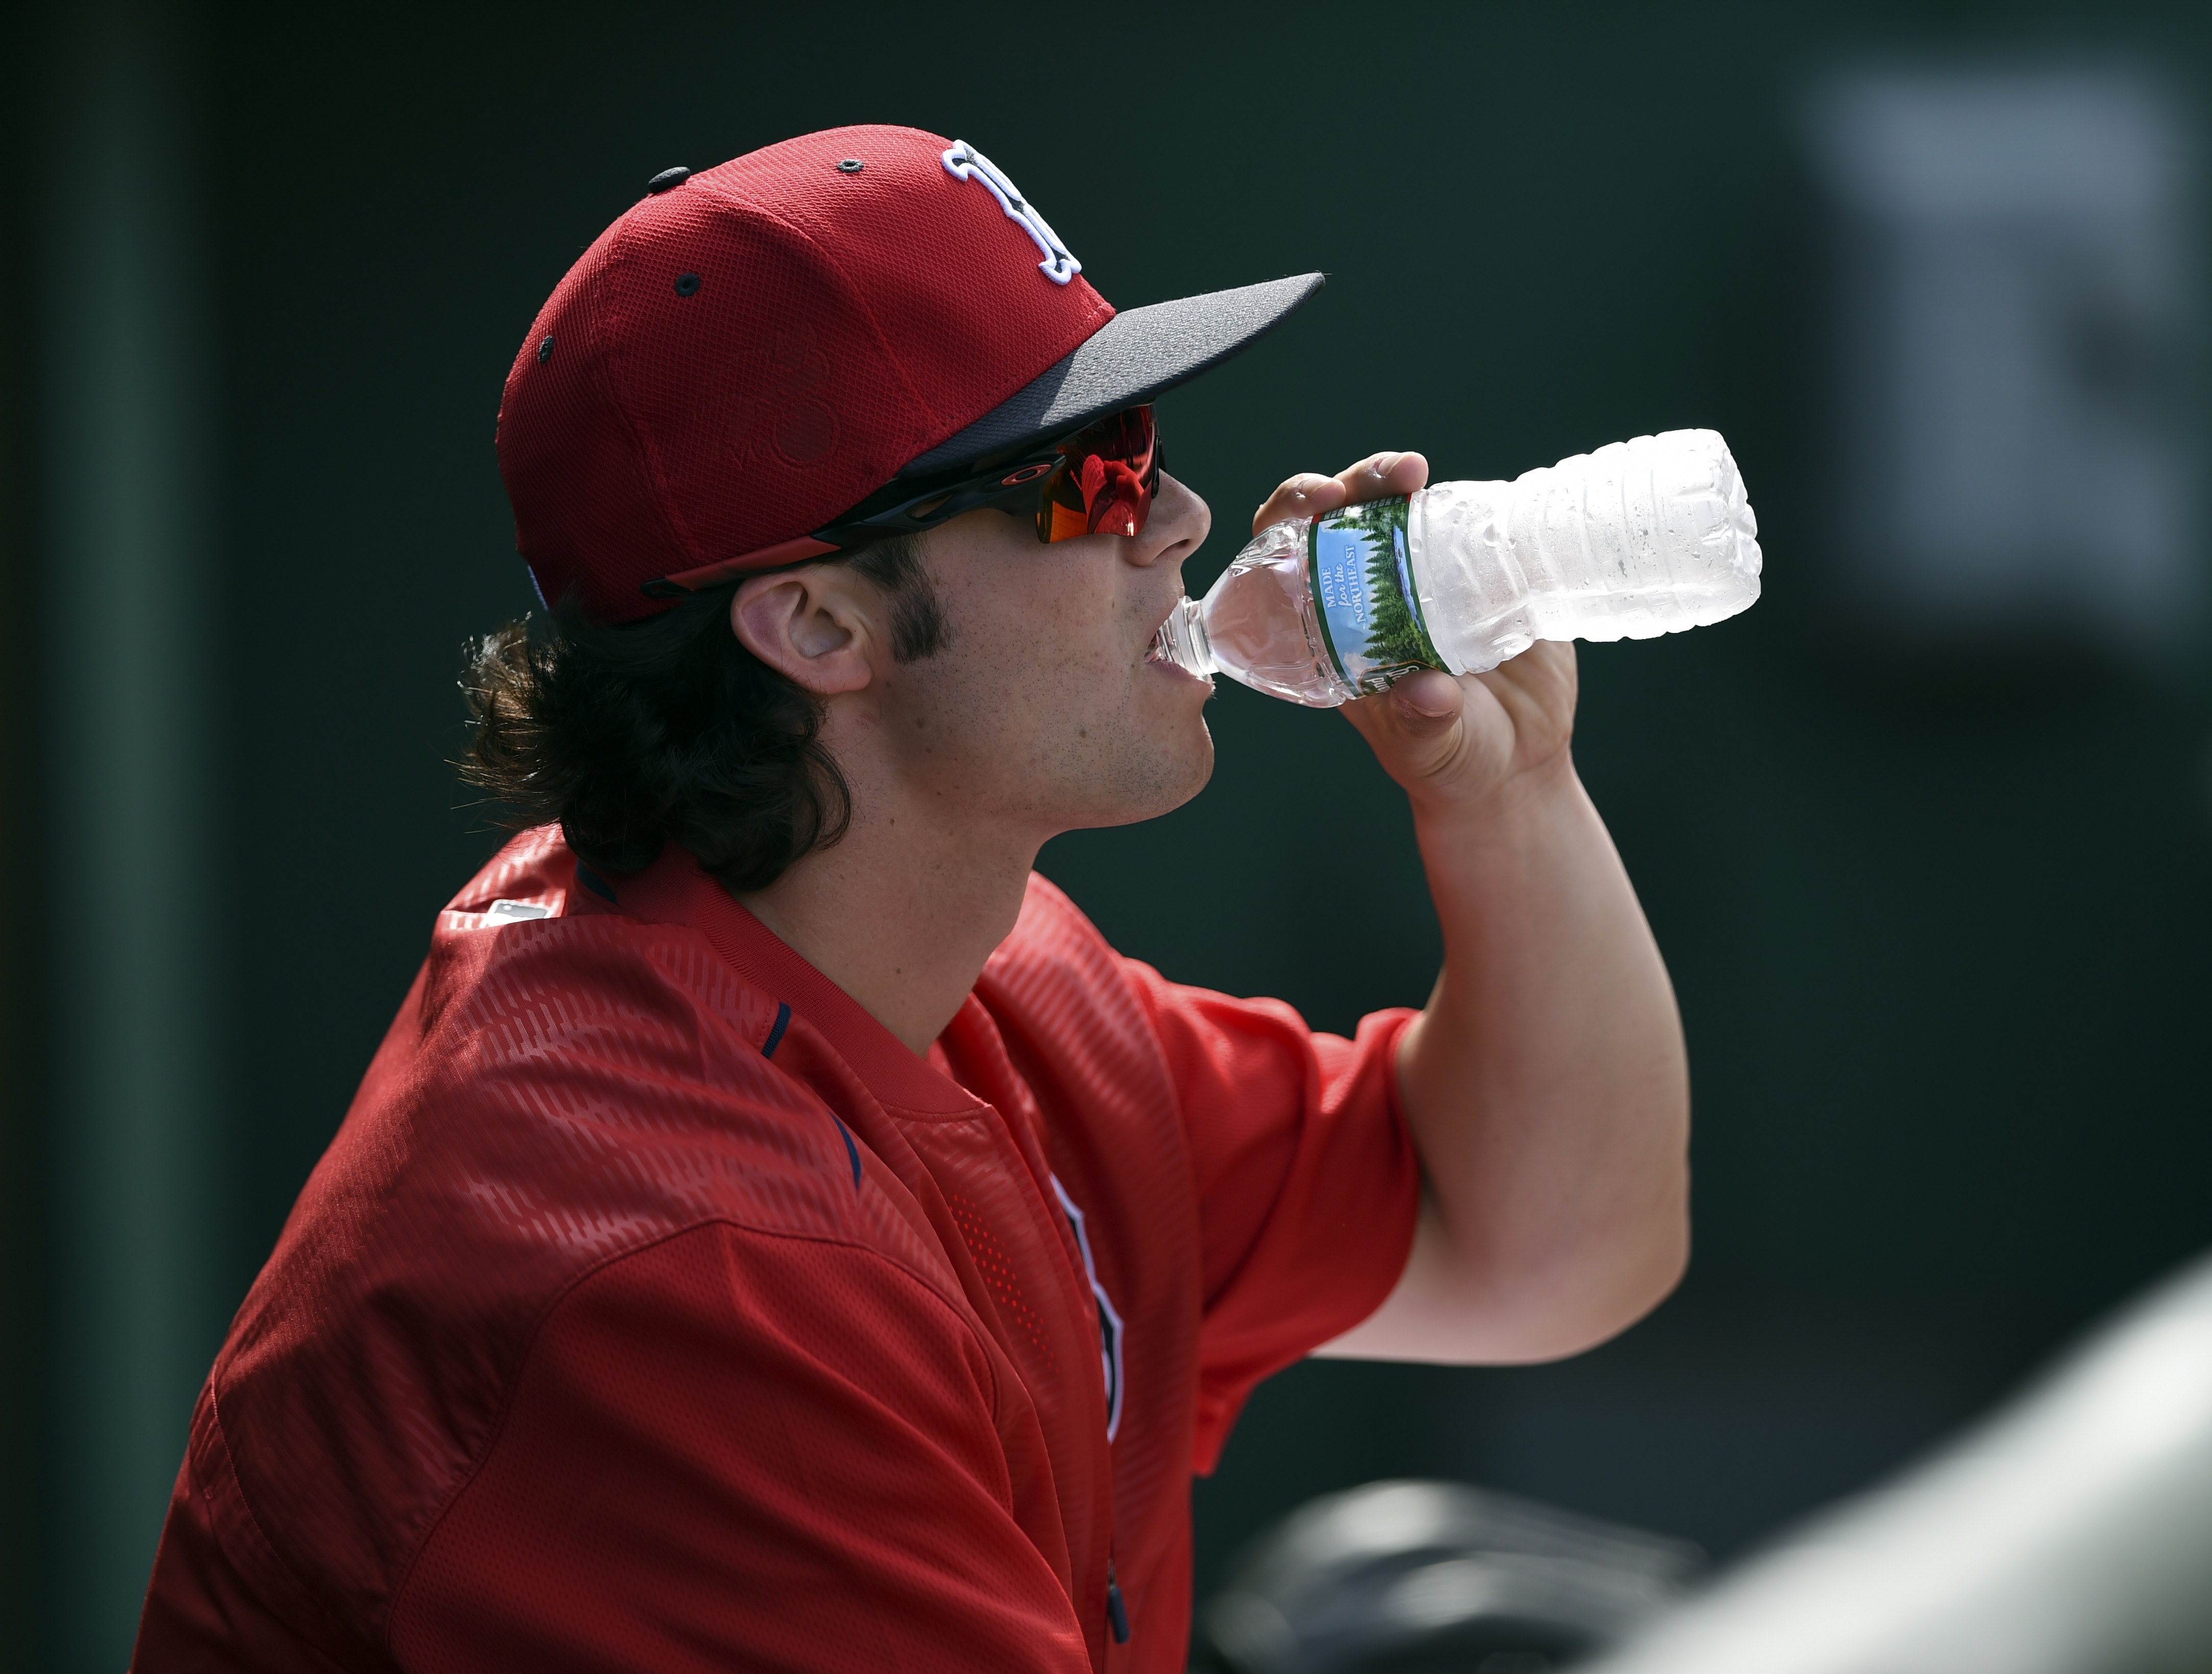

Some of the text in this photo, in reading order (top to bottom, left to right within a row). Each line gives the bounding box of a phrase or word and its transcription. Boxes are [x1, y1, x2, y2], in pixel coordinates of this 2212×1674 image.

[1321, 567, 1337, 608] MADE
[1334, 563, 1352, 606] for the
[1345, 546, 1366, 623] NORTHEAST
